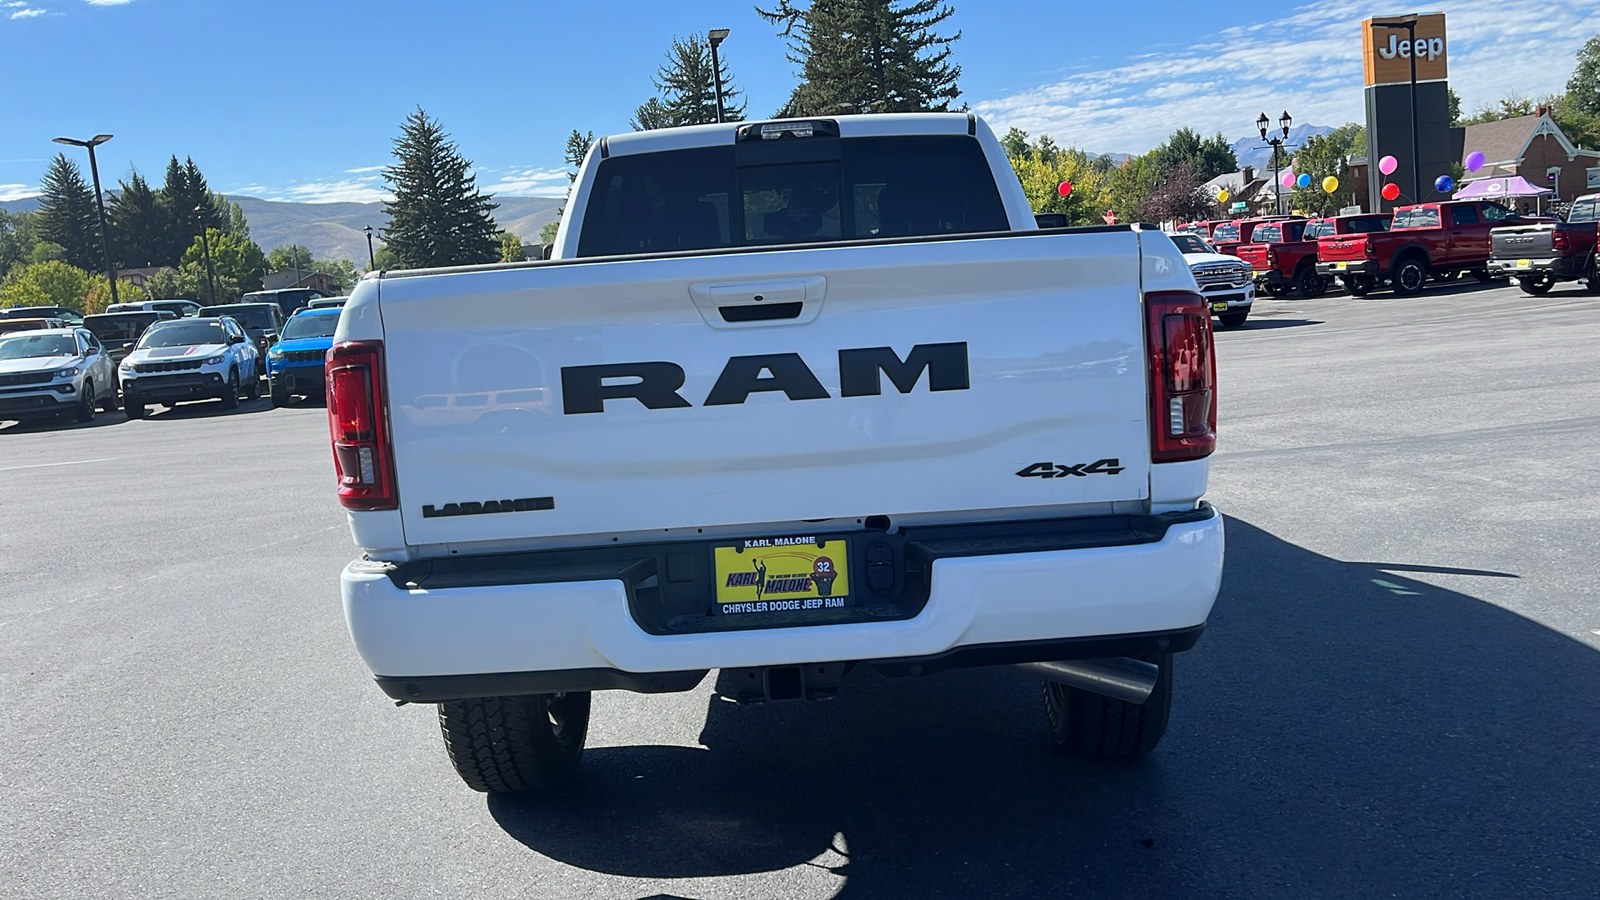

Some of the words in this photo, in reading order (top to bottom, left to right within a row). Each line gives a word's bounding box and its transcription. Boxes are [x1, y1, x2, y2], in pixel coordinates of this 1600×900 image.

[1379, 34, 1443, 61] Jeep
[561, 341, 970, 414] RAM
[1015, 458, 1126, 479] 4x4
[422, 496, 555, 518] LARAMIE
[744, 538, 772, 548] KARL
[774, 536, 816, 546] MALONE
[817, 561, 830, 572] 32
[725, 571, 758, 587] KARL
[764, 577, 813, 594] MALONE
[722, 602, 768, 614] CHRYSLER
[769, 600, 801, 611] DODGE
[801, 598, 823, 609] JEEP
[825, 597, 845, 608] RAM
